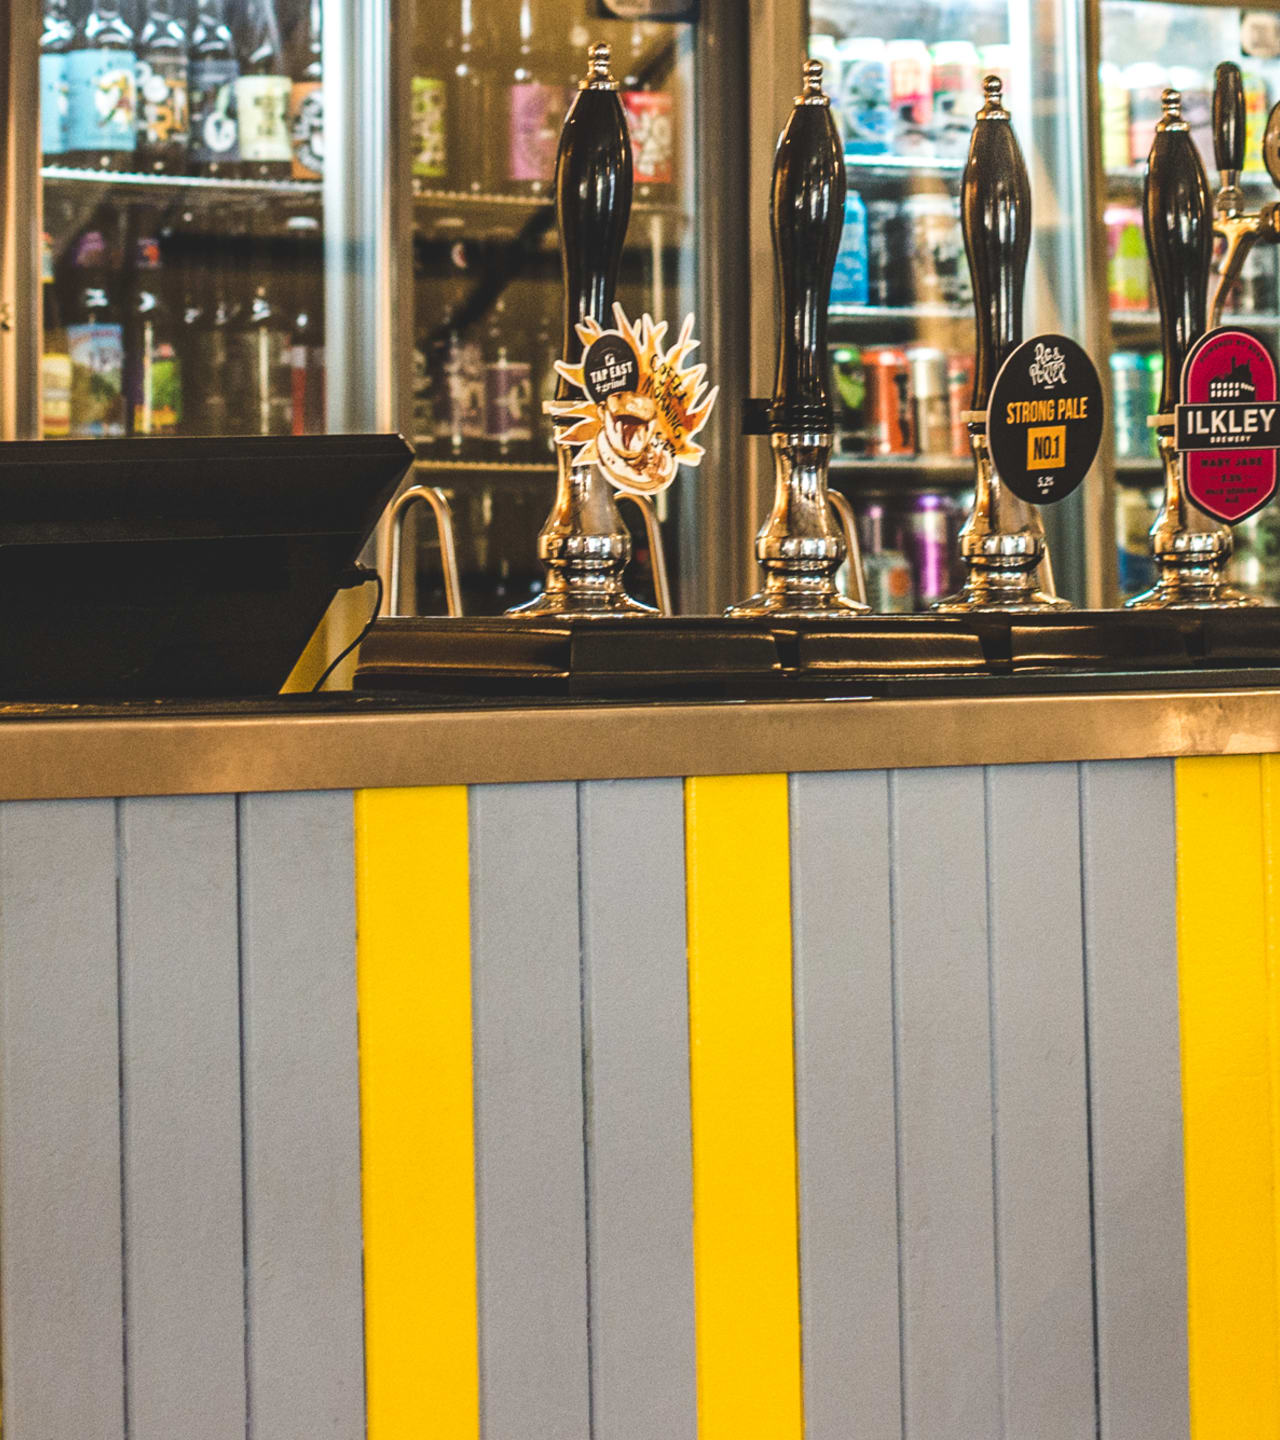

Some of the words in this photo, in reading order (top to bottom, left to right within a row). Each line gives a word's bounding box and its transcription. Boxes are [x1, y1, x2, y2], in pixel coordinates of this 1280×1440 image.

[590, 369, 609, 384] TAP
[609, 361, 633, 379] EAST
[1006, 399, 1054, 425] STRONG
[1057, 396, 1088, 420] PALE
[1187, 408, 1276, 435] ILKLEY
[1033, 435, 1060, 460] NO.1
[1210, 435, 1252, 444] BREWERY
